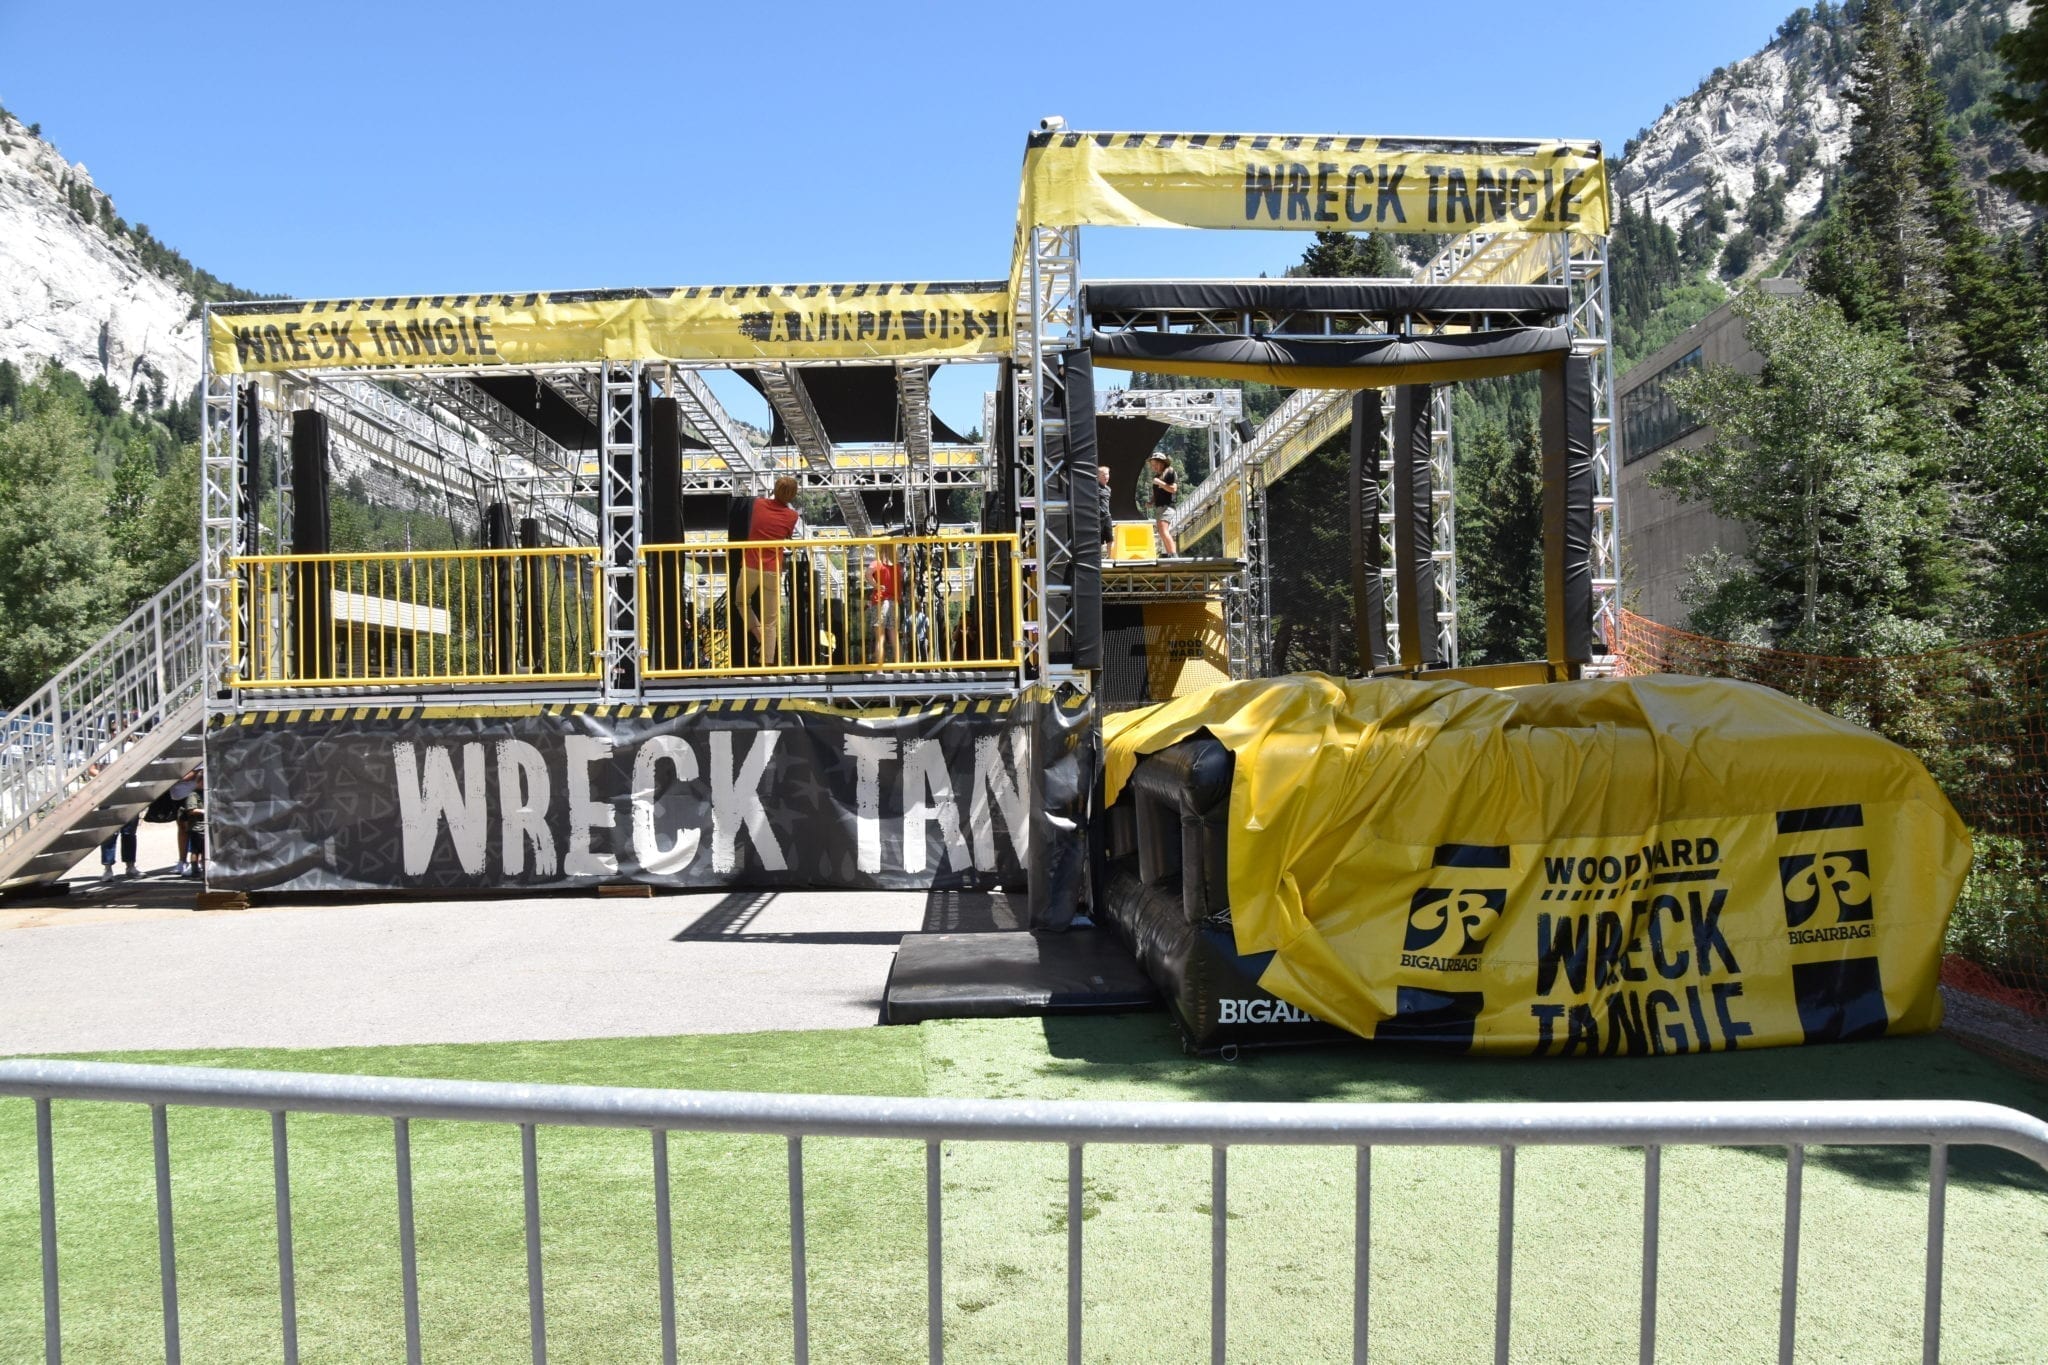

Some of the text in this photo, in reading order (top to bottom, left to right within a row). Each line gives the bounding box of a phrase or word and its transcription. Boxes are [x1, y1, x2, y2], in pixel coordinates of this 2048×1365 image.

[1244, 162, 1585, 224] WRECK TANGLE
[232, 315, 497, 364] WRECK TANGLE
[800, 310, 906, 342] NINJA
[393, 729, 787, 878] WRECK
[1536, 889, 1741, 996] WRECK
[1787, 924, 1871, 944] BIGAIRBAG
[1400, 954, 1478, 972] BIGAIRBAG
